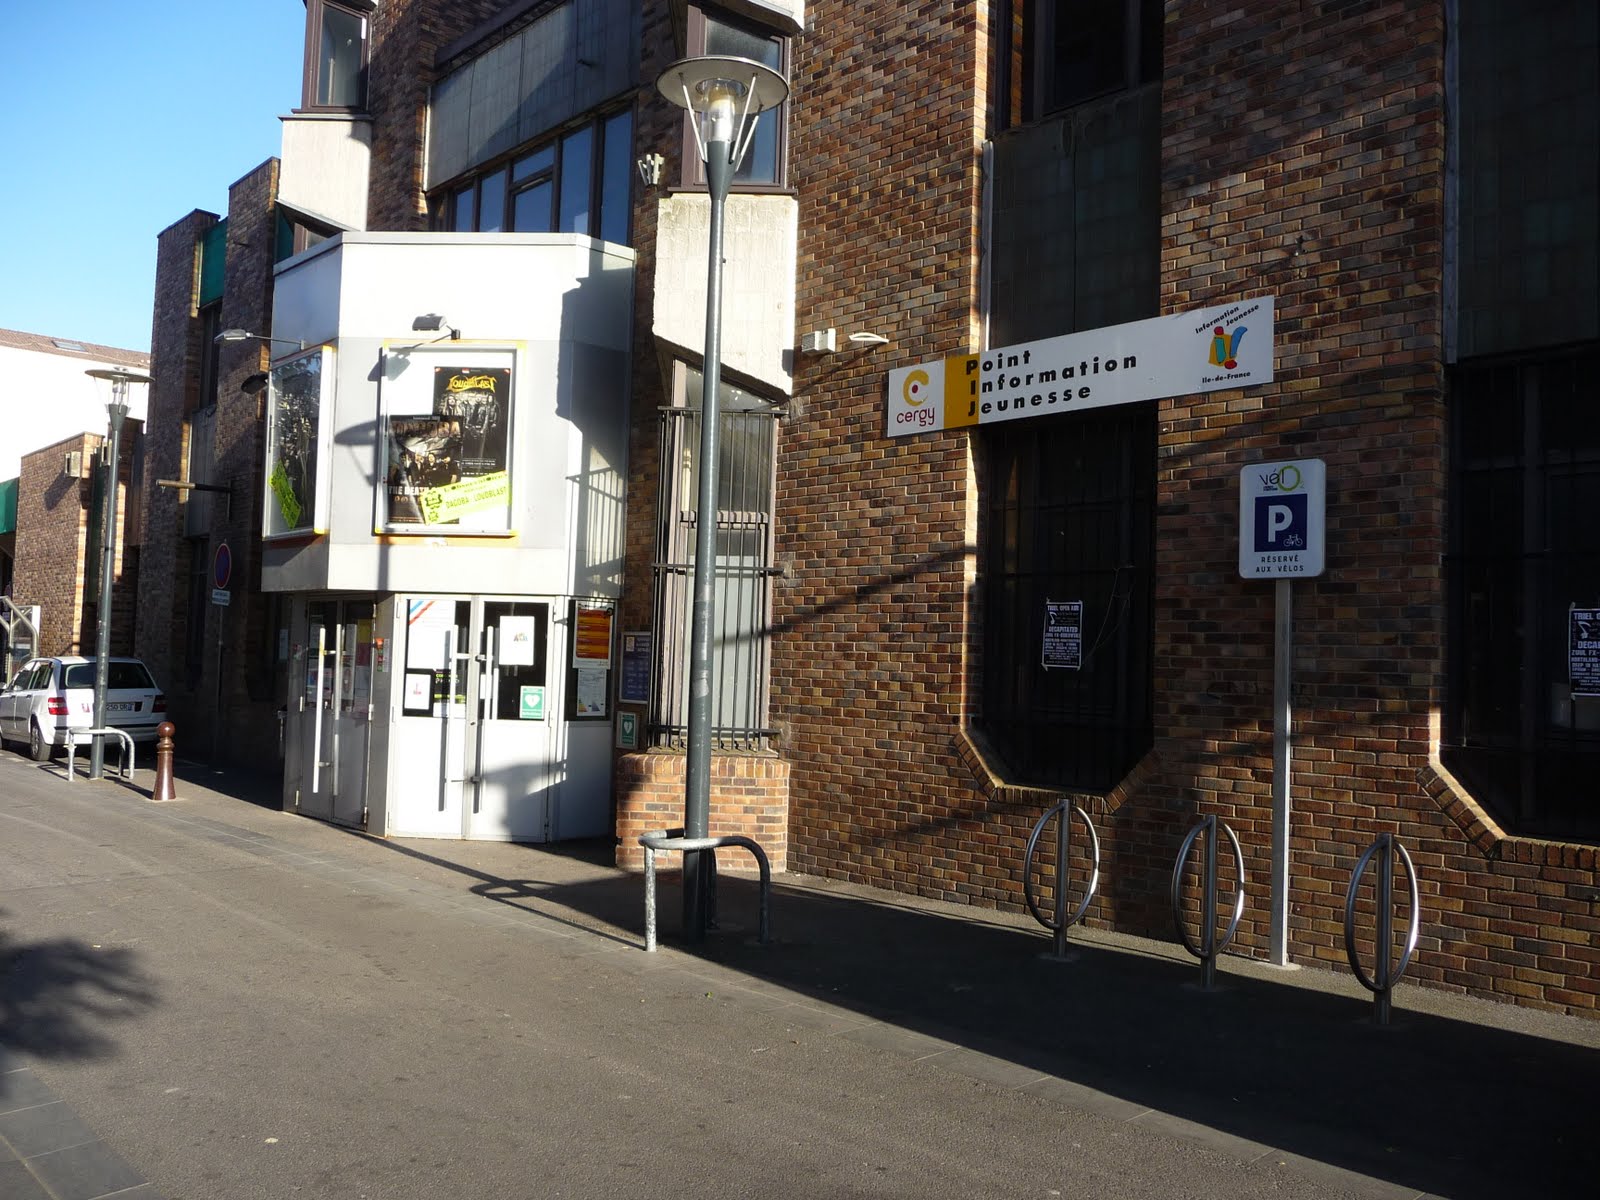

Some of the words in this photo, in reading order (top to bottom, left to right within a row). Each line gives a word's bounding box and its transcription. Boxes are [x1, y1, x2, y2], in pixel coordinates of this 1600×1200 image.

[1195, 306, 1240, 334] Information
[1226, 303, 1260, 326] Jeunesse
[966, 350, 1031, 375] Point
[970, 353, 1137, 395] Information
[968, 384, 1091, 417] Jeunesse
[896, 406, 935, 427] cergy
[1268, 504, 1293, 543] P
[1261, 554, 1299, 563] RÉSERVÉ
[1278, 564, 1304, 572] VÉLOS
[1573, 612, 1594, 620] TRIEL
